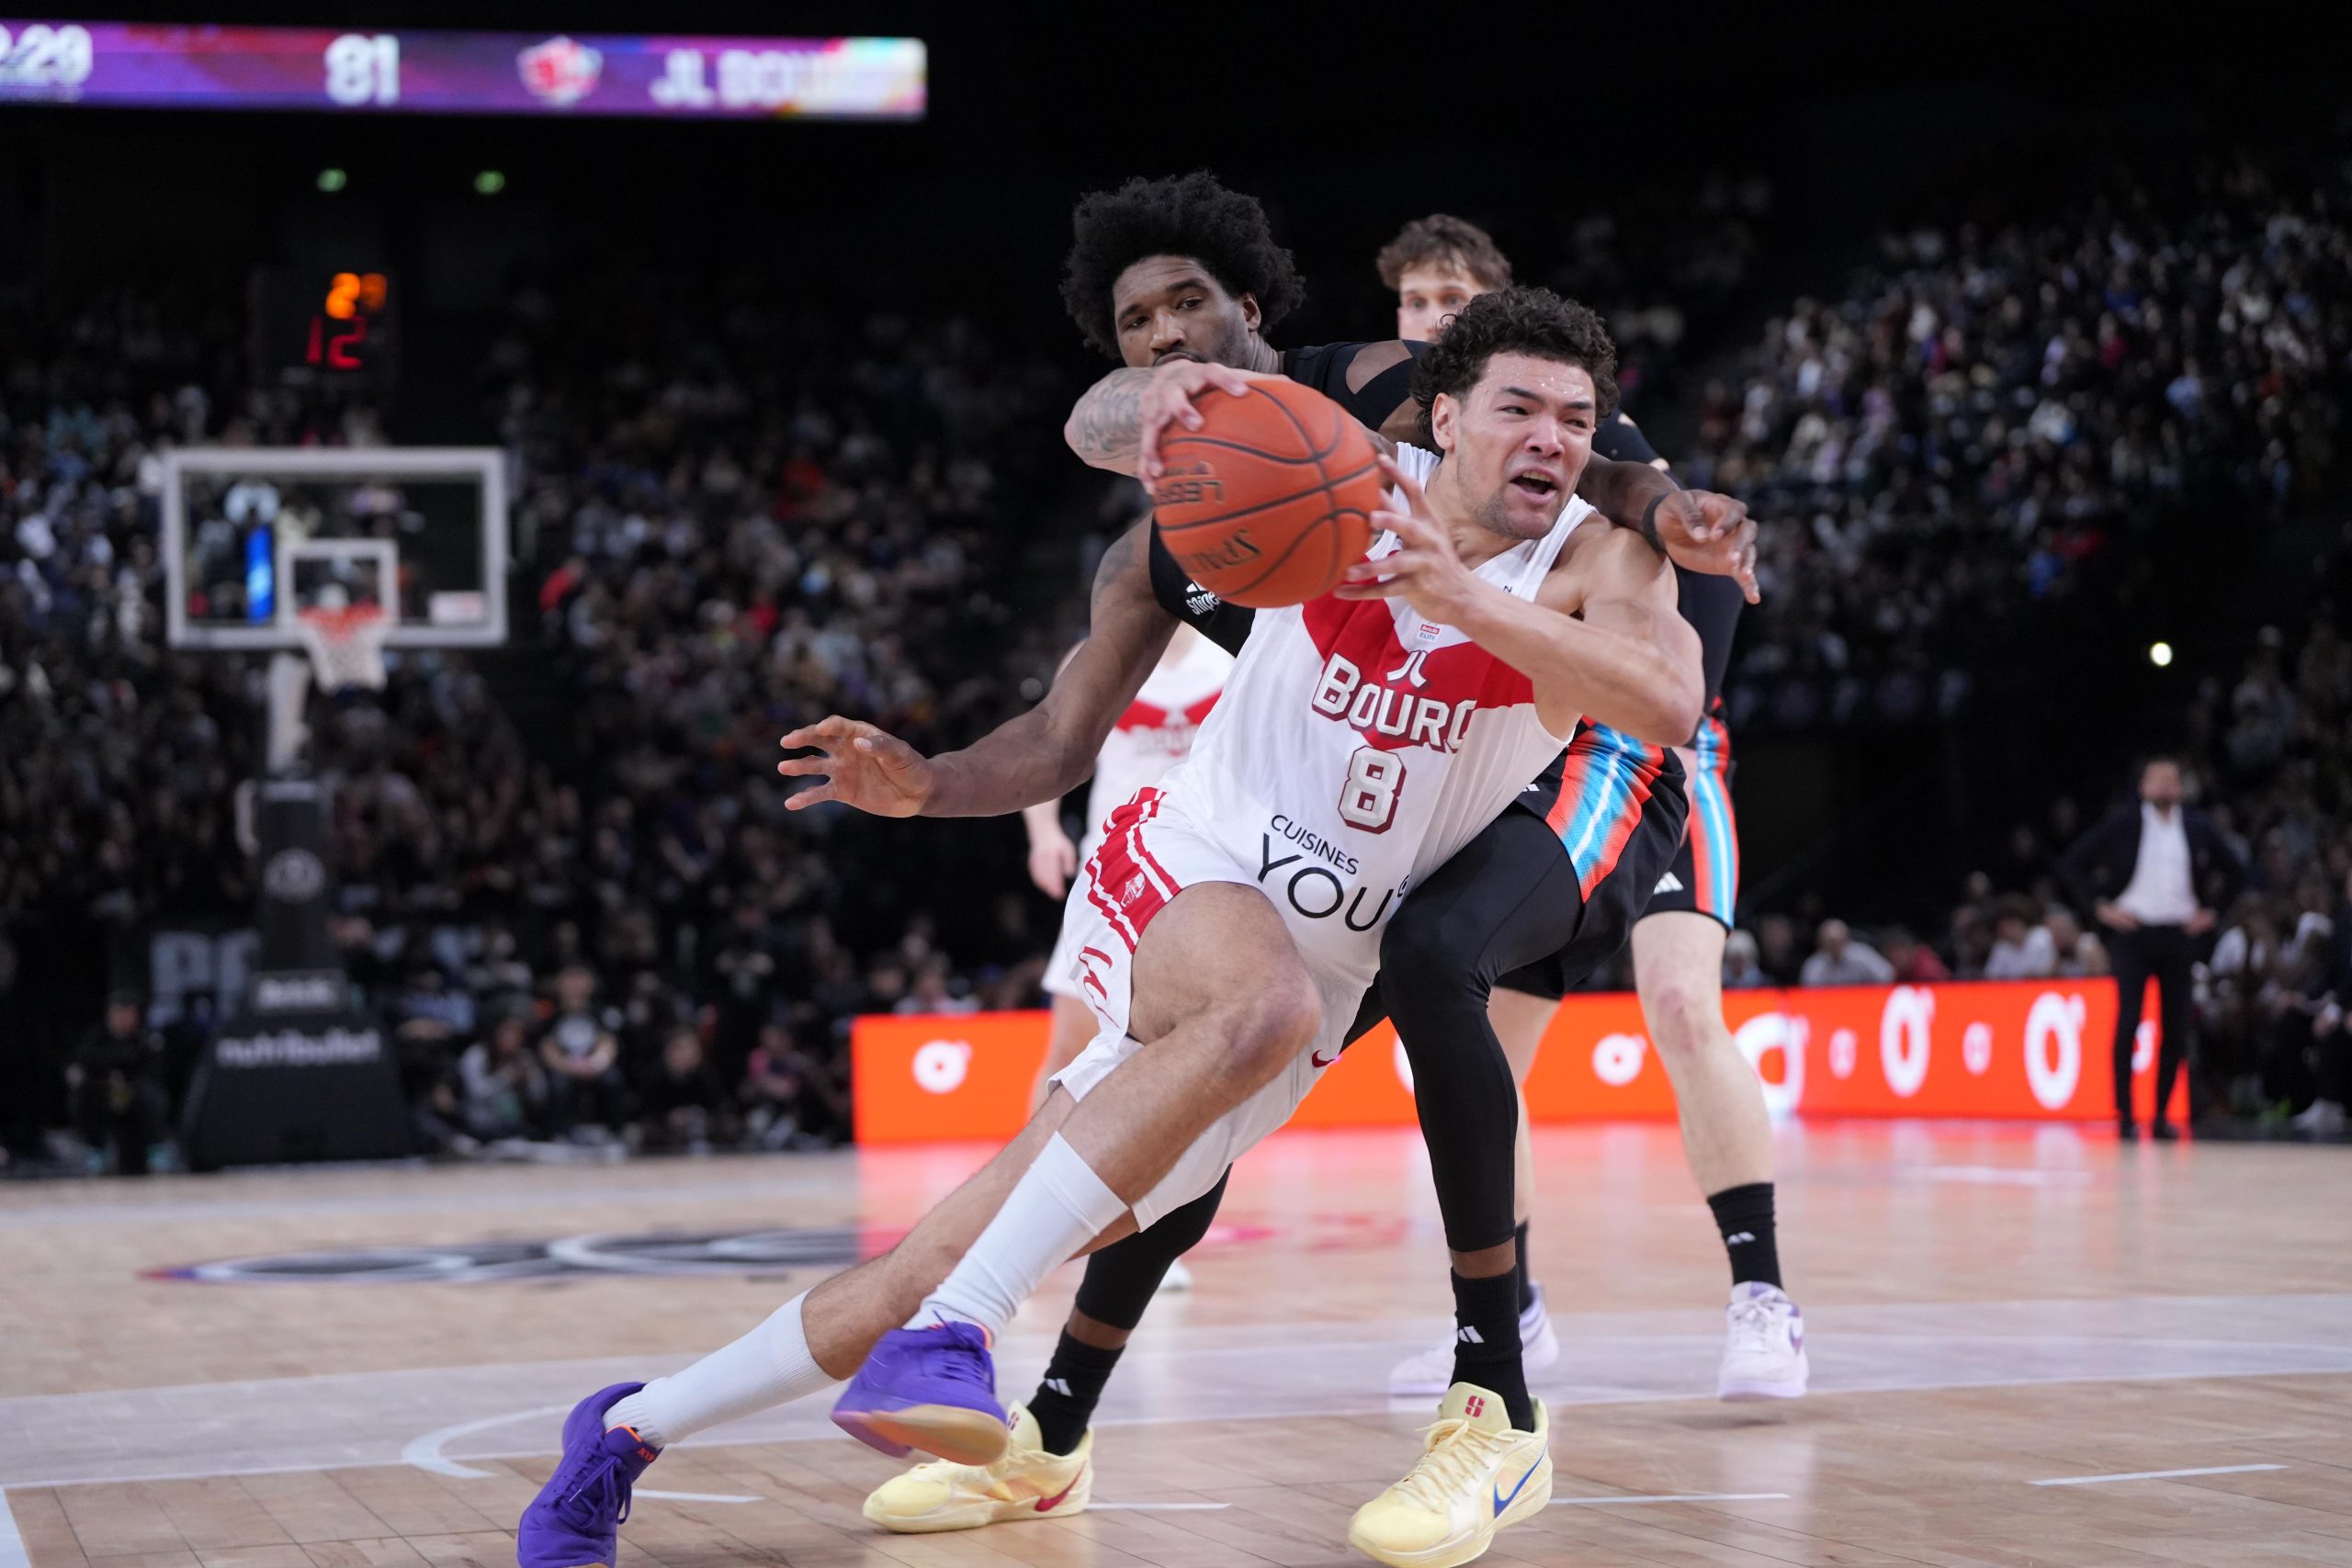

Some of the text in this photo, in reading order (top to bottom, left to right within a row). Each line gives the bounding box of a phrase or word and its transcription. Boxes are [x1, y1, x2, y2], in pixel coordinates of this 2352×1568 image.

[1338, 745, 1407, 835] 8
[1257, 832, 1395, 932] YOU
[1271, 814, 1360, 875] CUISINES
